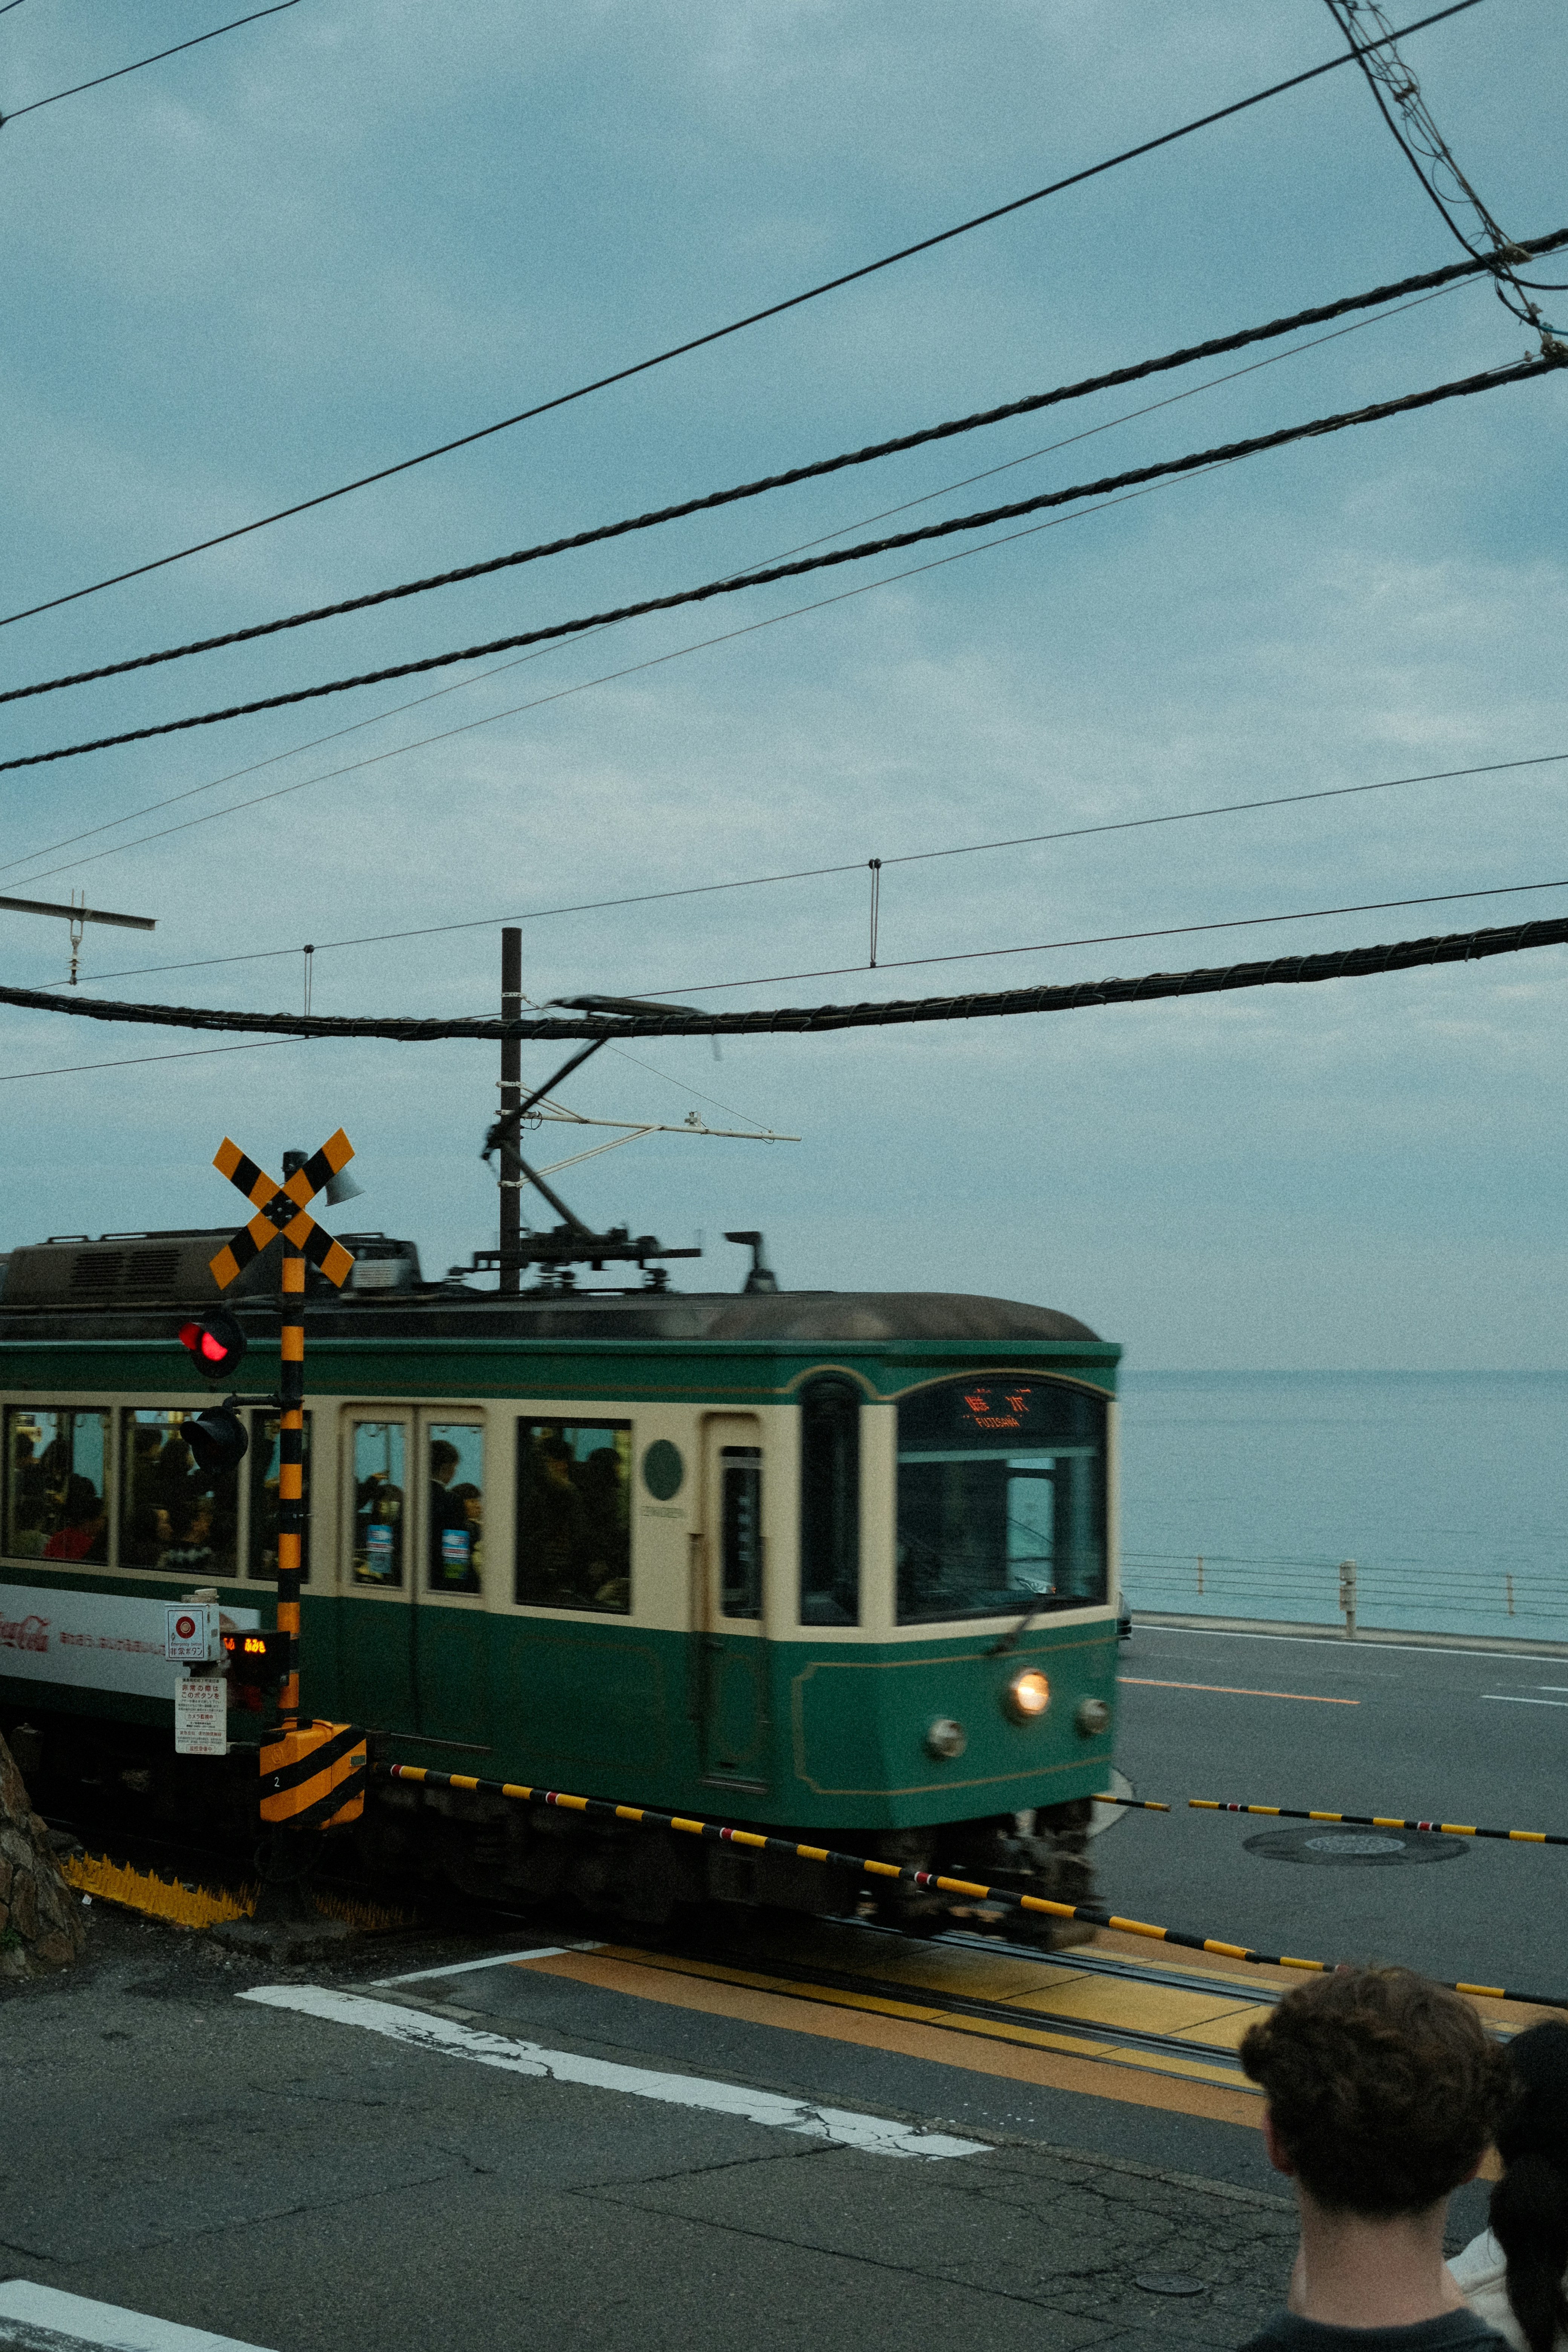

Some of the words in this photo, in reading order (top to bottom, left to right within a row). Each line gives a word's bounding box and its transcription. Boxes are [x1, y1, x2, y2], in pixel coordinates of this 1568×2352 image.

[975, 1417, 1020, 1428] FUJISAWA
[170, 1647, 202, 1656] 非常ボタン
[274, 1776, 280, 1787] 2
